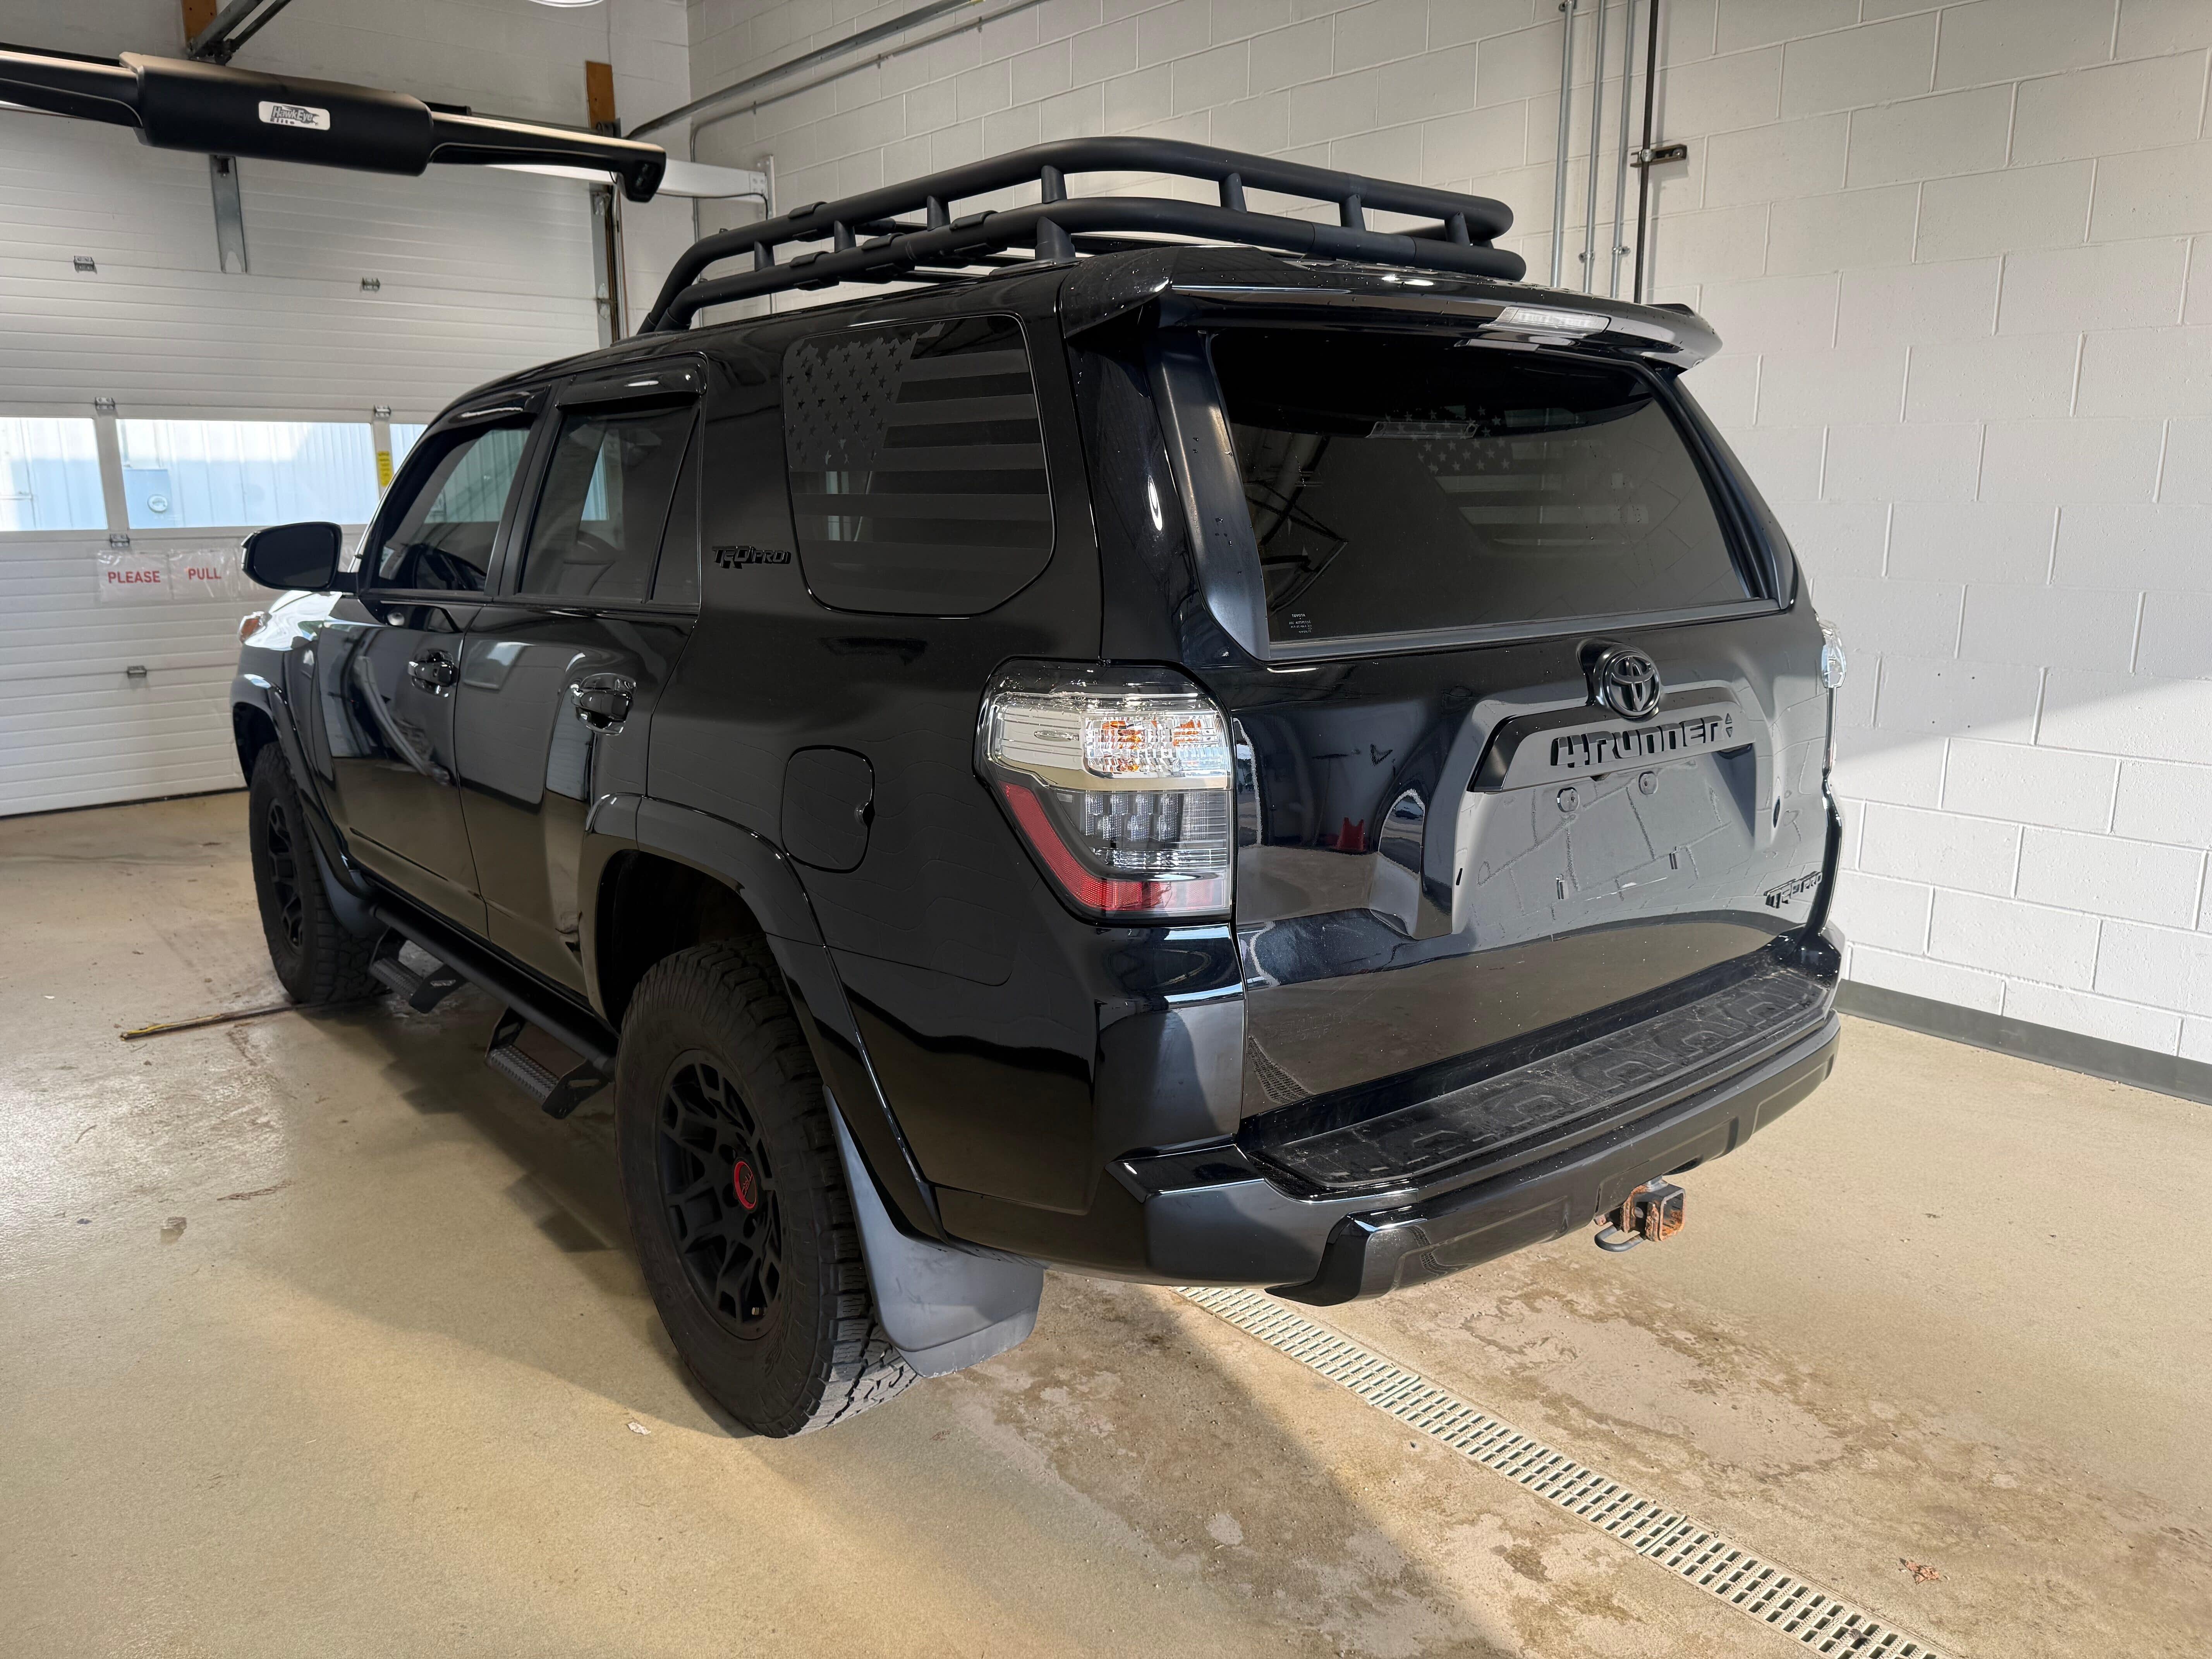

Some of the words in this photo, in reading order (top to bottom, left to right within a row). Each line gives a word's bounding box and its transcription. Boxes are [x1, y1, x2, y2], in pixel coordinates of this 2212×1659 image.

[271, 105, 314, 123] HawkEye
[712, 545, 755, 569] TRD
[752, 550, 792, 564] PRO
[108, 570, 161, 584] PLEASE
[188, 568, 222, 580] PULL
